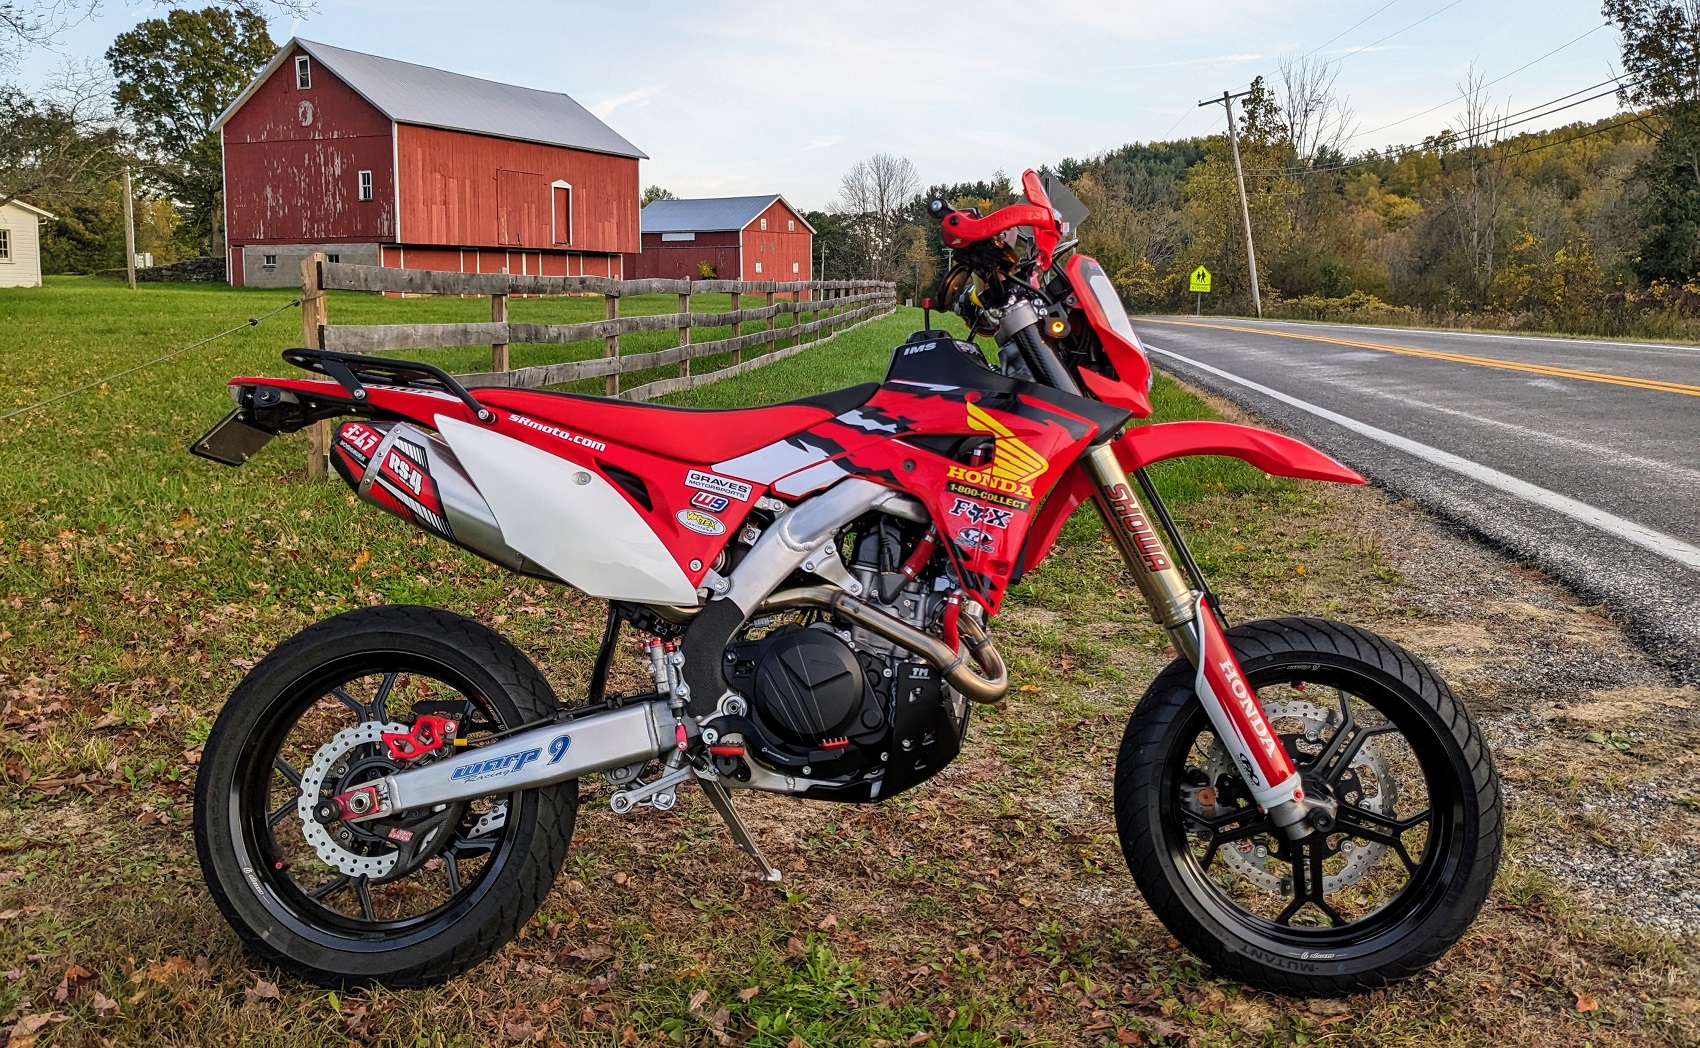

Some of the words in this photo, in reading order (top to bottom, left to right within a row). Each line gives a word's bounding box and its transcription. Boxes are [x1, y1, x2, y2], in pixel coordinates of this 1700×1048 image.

[903, 342, 937, 356] IMS
[688, 479, 746, 499] MOTORSPORTS
[690, 473, 748, 494] GRAVES
[946, 465, 1035, 499] HONDA
[950, 483, 1028, 510] 1-800-COLLECT
[1104, 483, 1171, 572] SHOWA
[912, 667, 929, 677] TM
[1219, 657, 1277, 759] HONDA
[547, 734, 572, 766] 9
[464, 769, 511, 784] Racing
[1240, 945, 1315, 972] MUTANT
